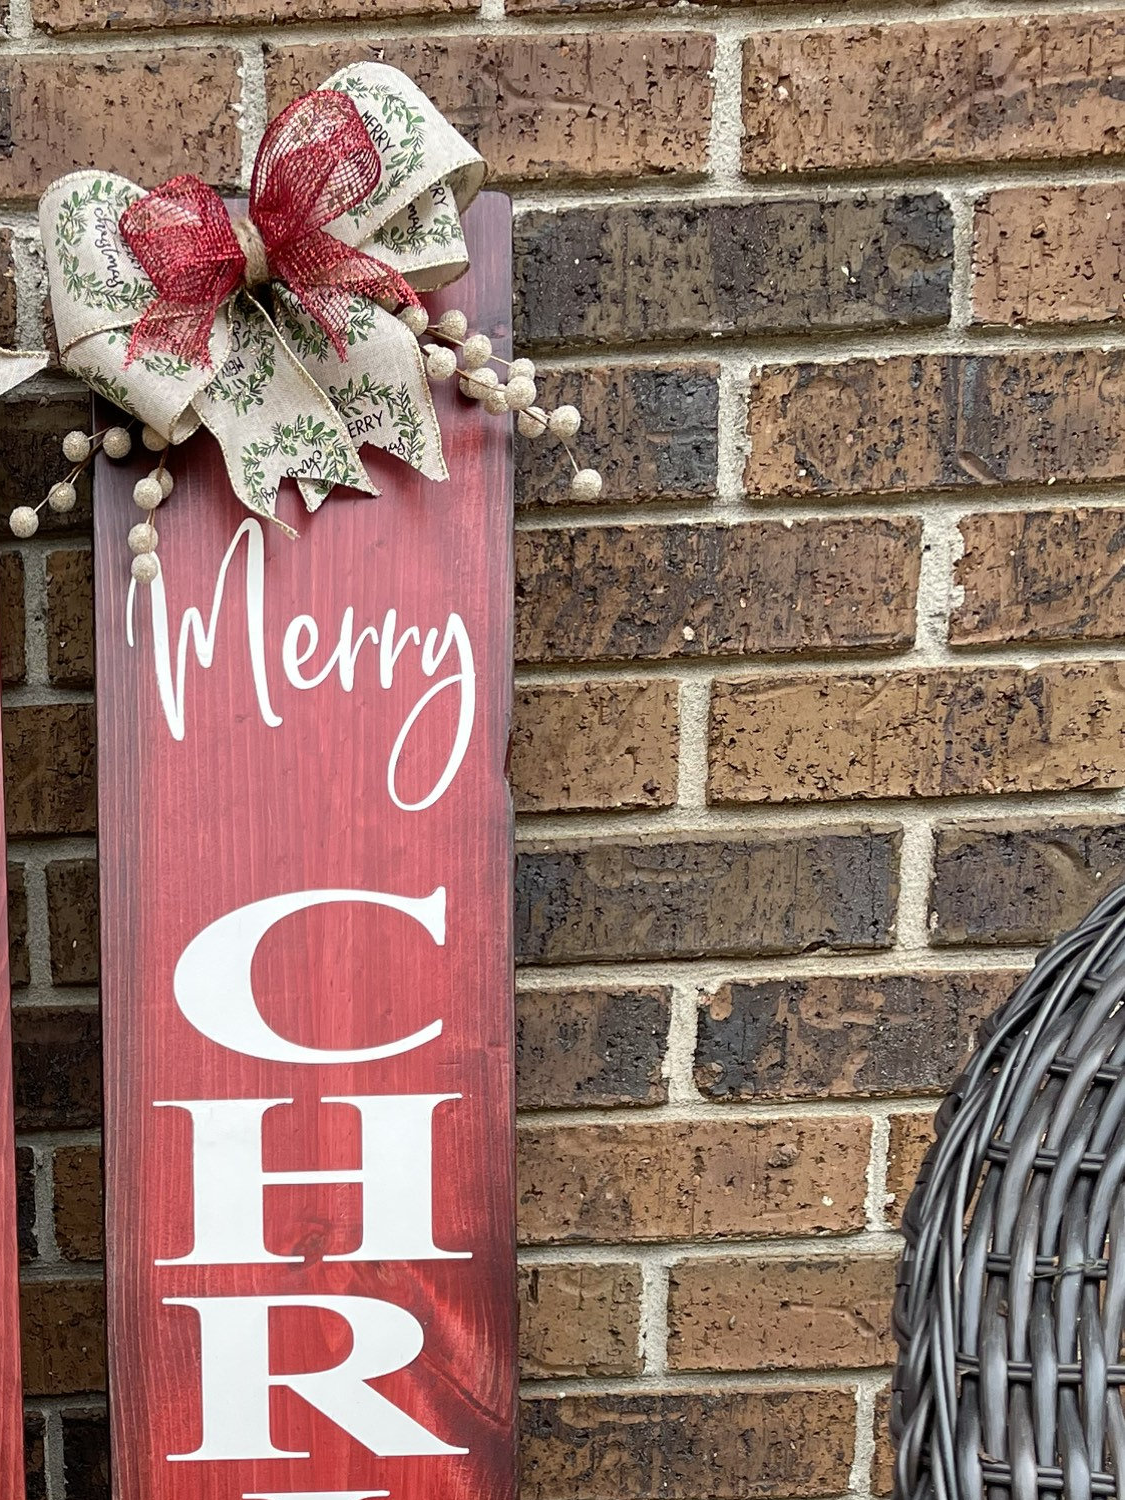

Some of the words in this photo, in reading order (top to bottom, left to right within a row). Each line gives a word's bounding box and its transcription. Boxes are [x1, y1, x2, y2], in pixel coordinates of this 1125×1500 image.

[361, 110, 396, 154] MERRY
[347, 401, 384, 439] ERRY
[125, 516, 476, 812] Merry
